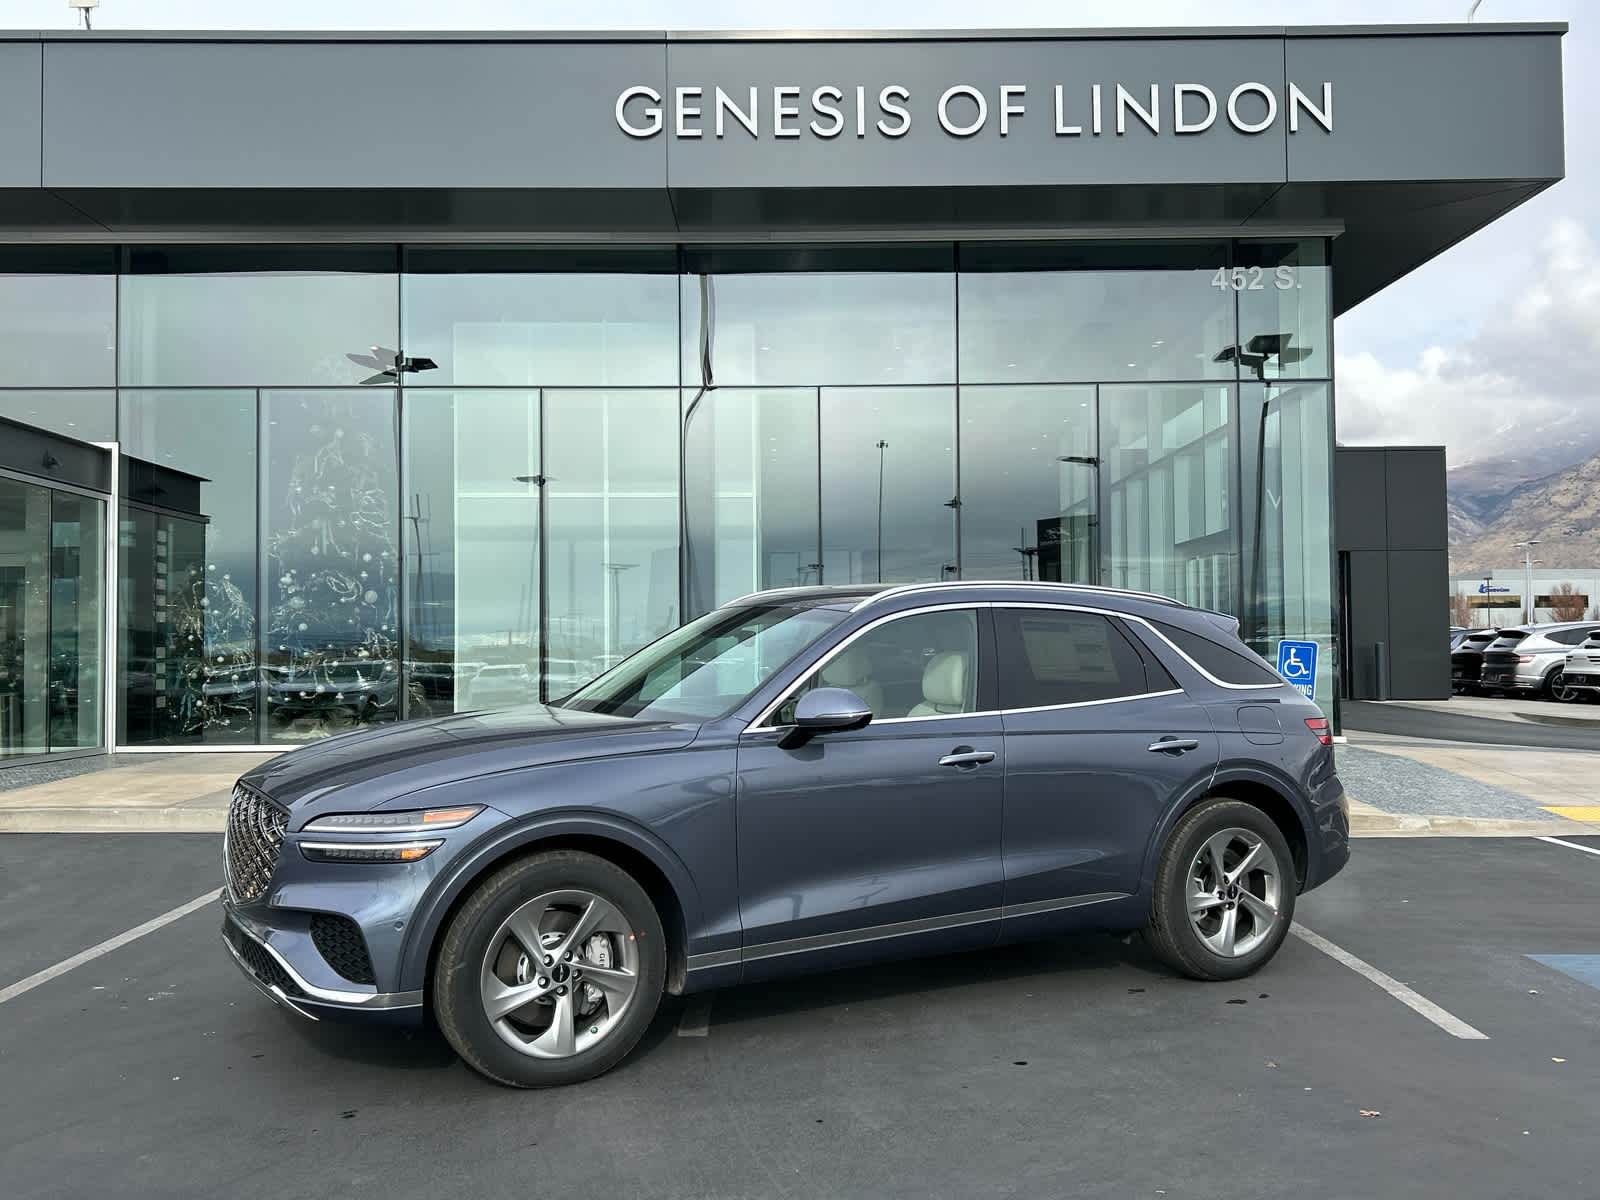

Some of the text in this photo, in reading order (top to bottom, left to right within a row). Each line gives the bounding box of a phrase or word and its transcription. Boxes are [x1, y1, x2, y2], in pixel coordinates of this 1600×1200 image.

[615, 82, 1334, 138] GENESIS OF LINDON
[1211, 265, 1302, 291] 452 S.
